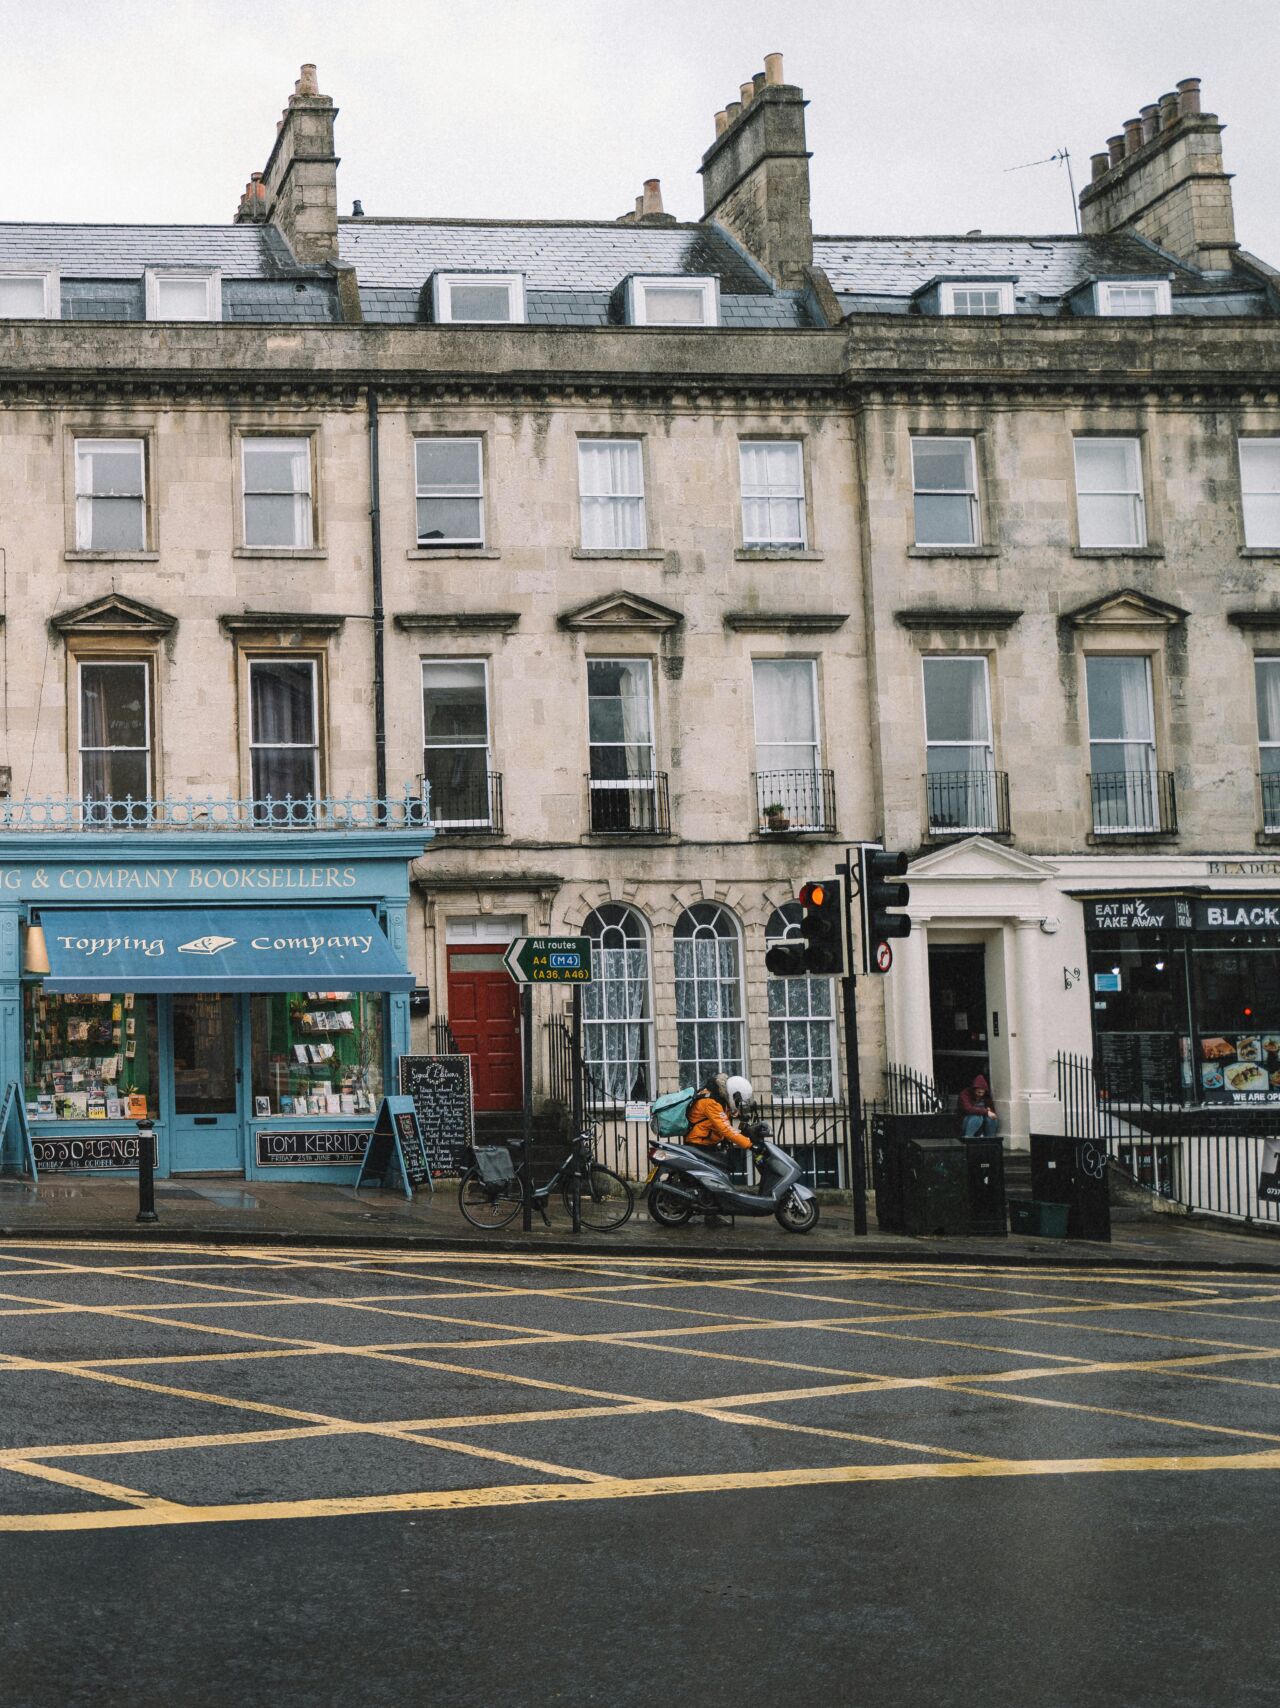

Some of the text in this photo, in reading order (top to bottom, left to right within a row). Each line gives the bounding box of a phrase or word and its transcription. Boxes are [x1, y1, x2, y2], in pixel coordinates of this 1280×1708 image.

[31, 868, 50, 889] &
[59, 868, 178, 889] COMPANY
[188, 867, 357, 888] BOOKSELLERS
[1095, 904, 1118, 916] EAT
[1122, 903, 1134, 915] IN
[1096, 915, 1165, 928] TAKE AWAY
[1207, 907, 1280, 926] BLACK
[57, 935, 165, 957] Topping
[251, 935, 373, 957] Company
[532, 941, 577, 949] All routes
[533, 955, 579, 966] A4 (M4)
[564, 969, 589, 979] A46)
[414, 996, 421, 1005] 2
[1232, 1092, 1280, 1101] WE ARE OP
[261, 1133, 369, 1153] TOM KERRIDG
